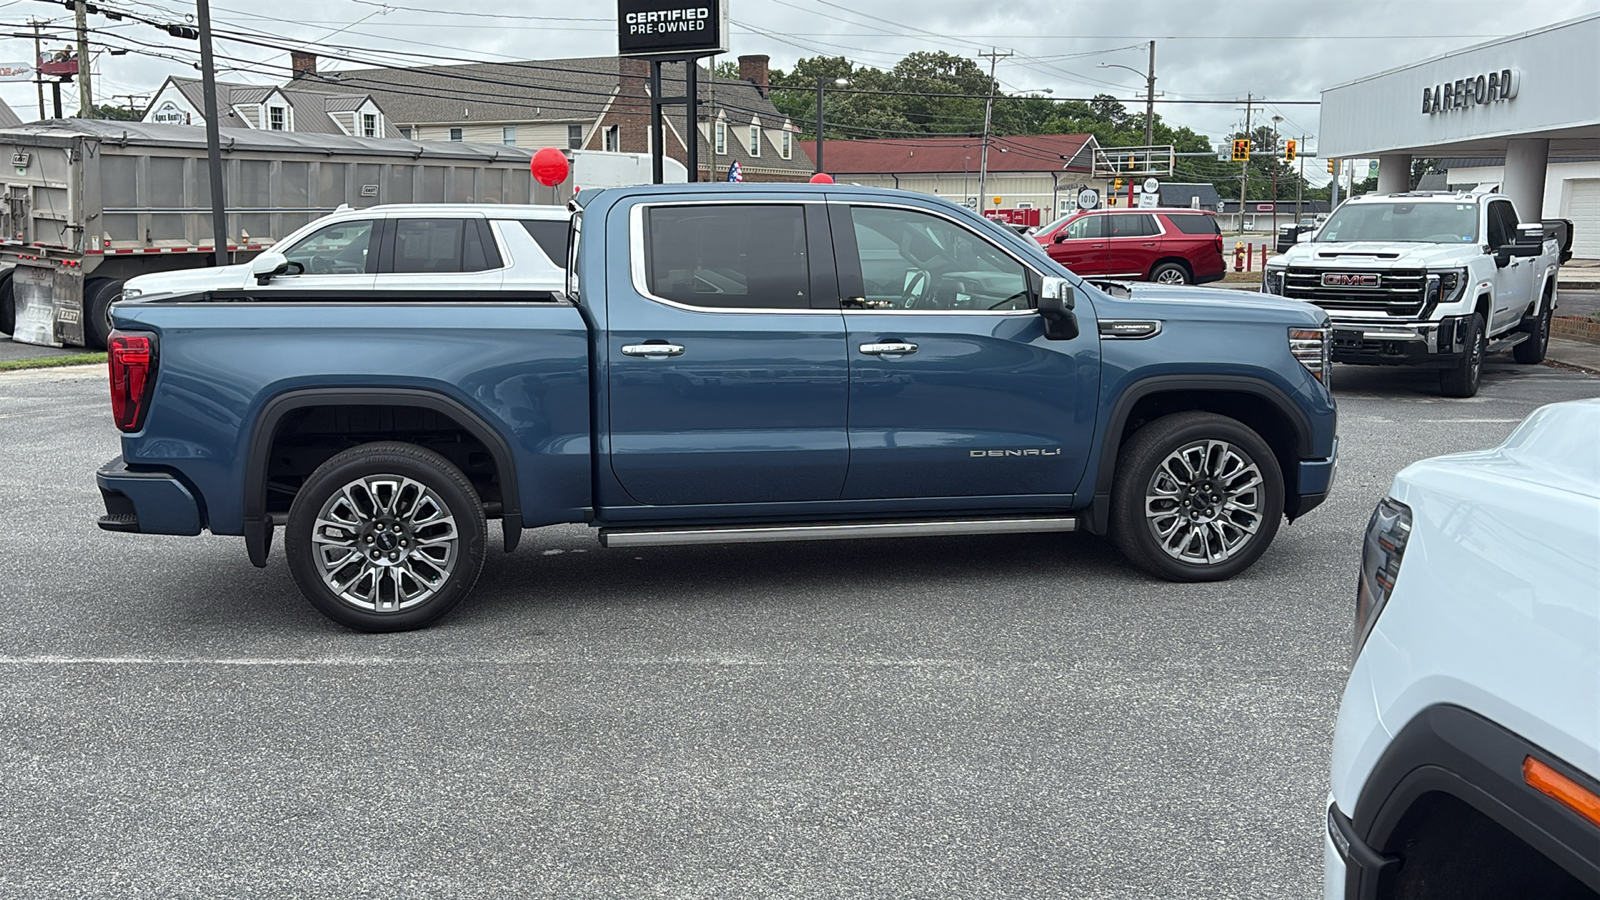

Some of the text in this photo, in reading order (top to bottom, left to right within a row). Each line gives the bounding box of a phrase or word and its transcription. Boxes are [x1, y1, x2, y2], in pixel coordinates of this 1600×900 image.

[626, 7, 709, 24] CERTIFIED
[630, 20, 705, 35] PRE-OWNED
[1422, 69, 1519, 114] BAREFORD
[1081, 195, 1096, 203] 1010
[1325, 274, 1377, 285] GMC
[60, 311, 77, 321] EAST
[969, 448, 1061, 457] DENALI
